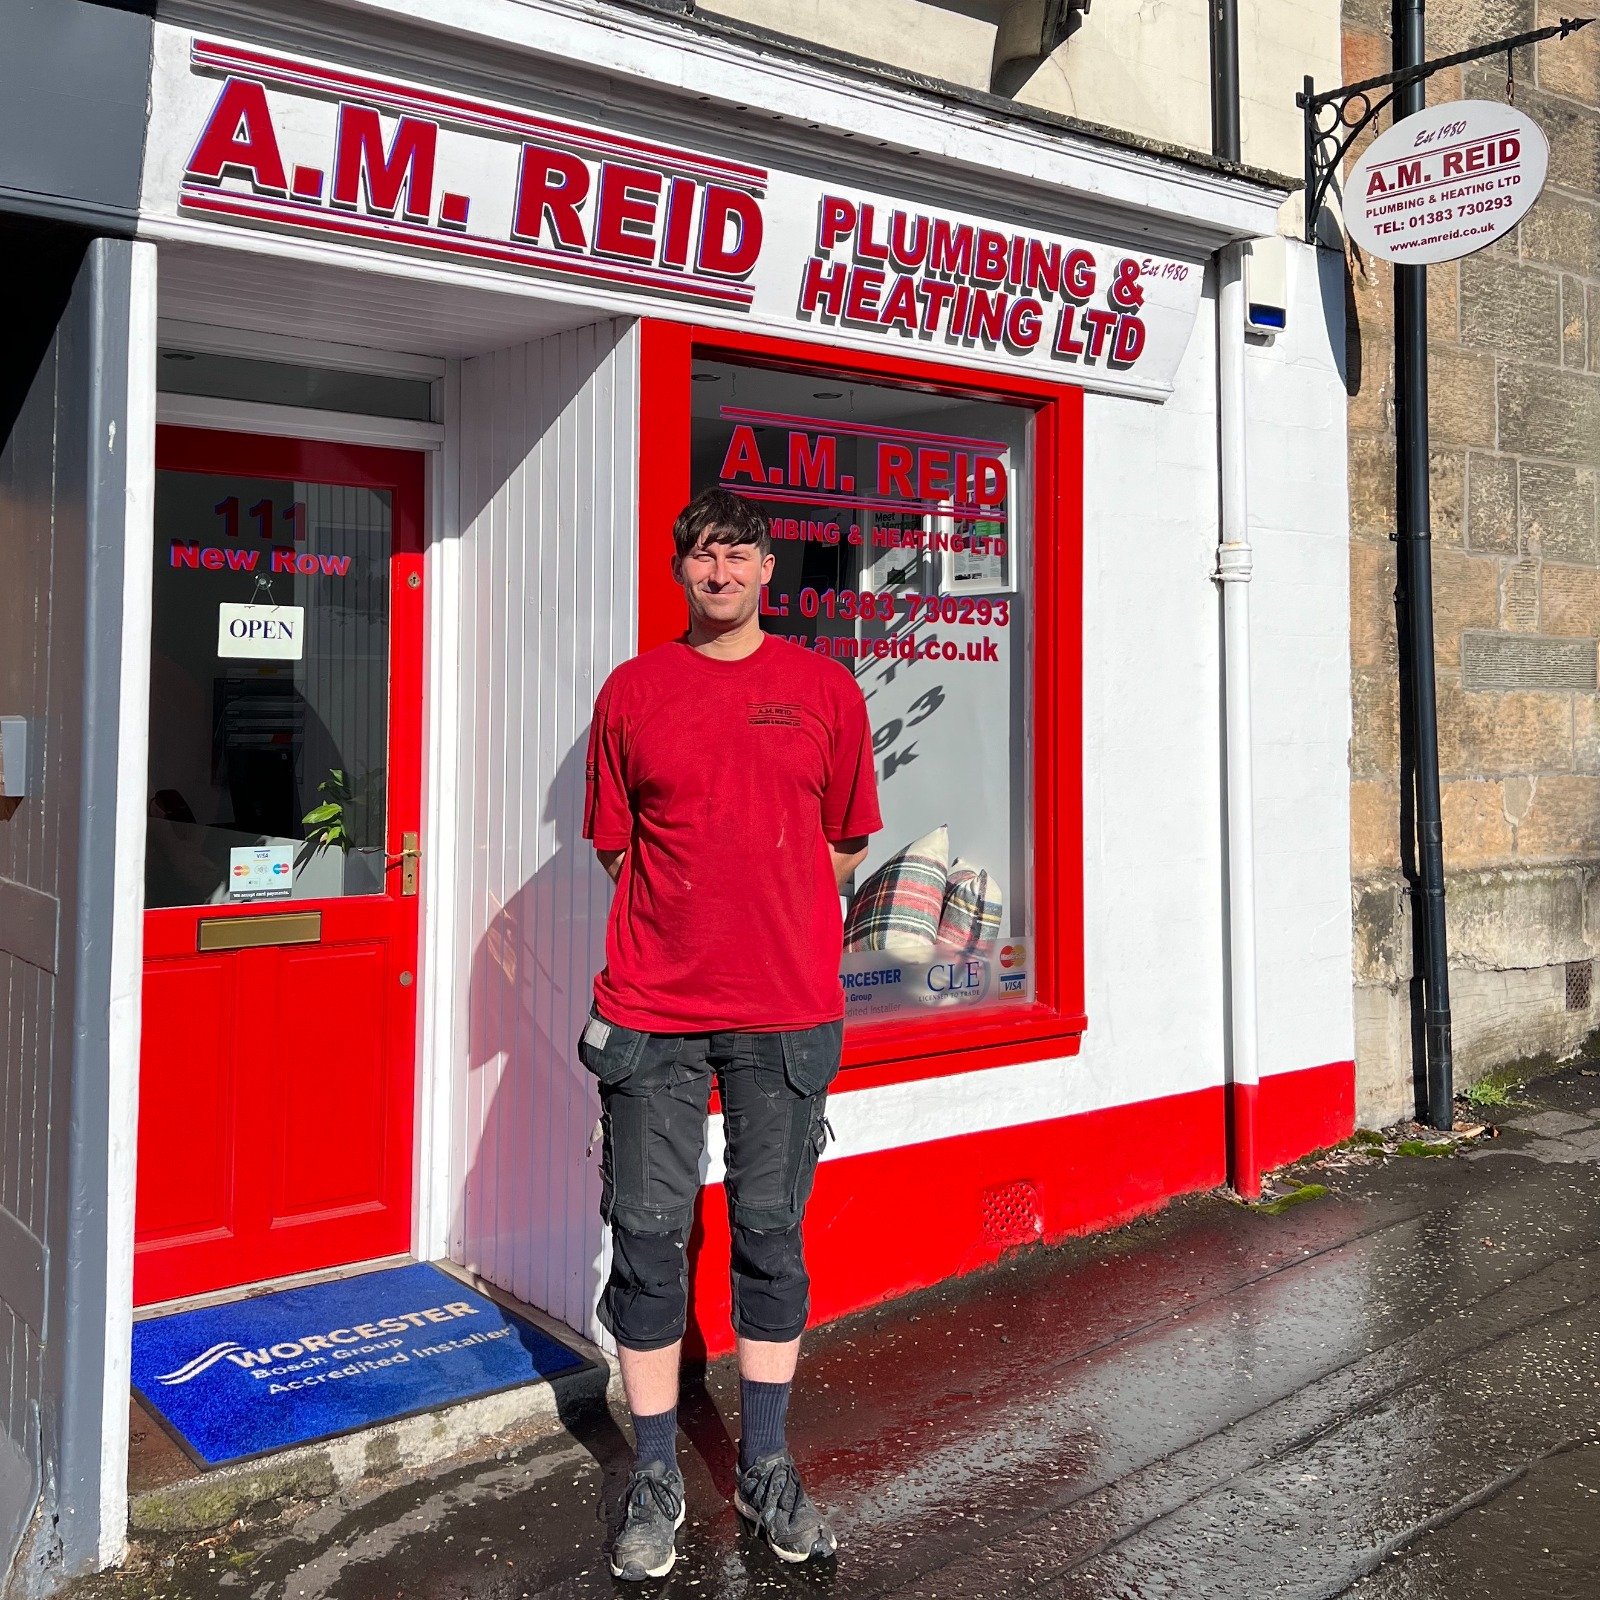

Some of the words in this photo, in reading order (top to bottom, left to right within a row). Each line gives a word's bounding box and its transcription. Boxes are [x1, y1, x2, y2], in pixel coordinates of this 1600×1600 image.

[1413, 130, 1436, 148] Est
[1437, 120, 1467, 141] 1980
[182, 75, 469, 223] A.M.
[511, 141, 765, 279] REID
[1366, 160, 1431, 196] A.M.
[1443, 138, 1521, 178] REID
[1366, 197, 1425, 219] PLUMBING
[1428, 195, 1437, 204] &
[1441, 181, 1494, 202] HEATING
[1497, 174, 1521, 189] LTD
[1374, 220, 1405, 236] TEL:
[1409, 209, 1453, 229] 01383
[1457, 195, 1513, 218] 730293
[818, 193, 1097, 299] PLUMBING
[1112, 258, 1146, 309] &
[1390, 222, 1495, 252] www.amreid.co.uk
[1140, 258, 1160, 278] Est
[1161, 261, 1189, 281] 1980
[800, 257, 1043, 349] HEATING
[1057, 303, 1146, 363] LTD
[720, 425, 855, 492] A.M.
[877, 442, 1008, 506] REID
[214, 496, 307, 541] 111
[768, 517, 840, 544] MBING
[848, 523, 863, 545] &
[872, 526, 964, 553] HEATING
[971, 536, 1007, 557] LTD
[170, 538, 260, 571] New
[270, 545, 351, 577] Row
[759, 585, 789, 617] L:
[800, 586, 895, 622] 01383
[904, 594, 1010, 627] 730293
[229, 618, 294, 640] OPEN
[918, 992, 949, 1002] LICENSED
[960, 989, 980, 997] TRADE
[927, 961, 980, 992] CLE
[1005, 980, 1022, 991] VISA
[850, 993, 873, 1002] Group
[870, 1002, 901, 1014] Installer
[228, 1302, 480, 1369] WORCESTER
[250, 1355, 327, 1380] Bosch
[331, 1337, 404, 1361] Group
[269, 1353, 409, 1395] Accredited
[412, 1326, 514, 1358] Installer
